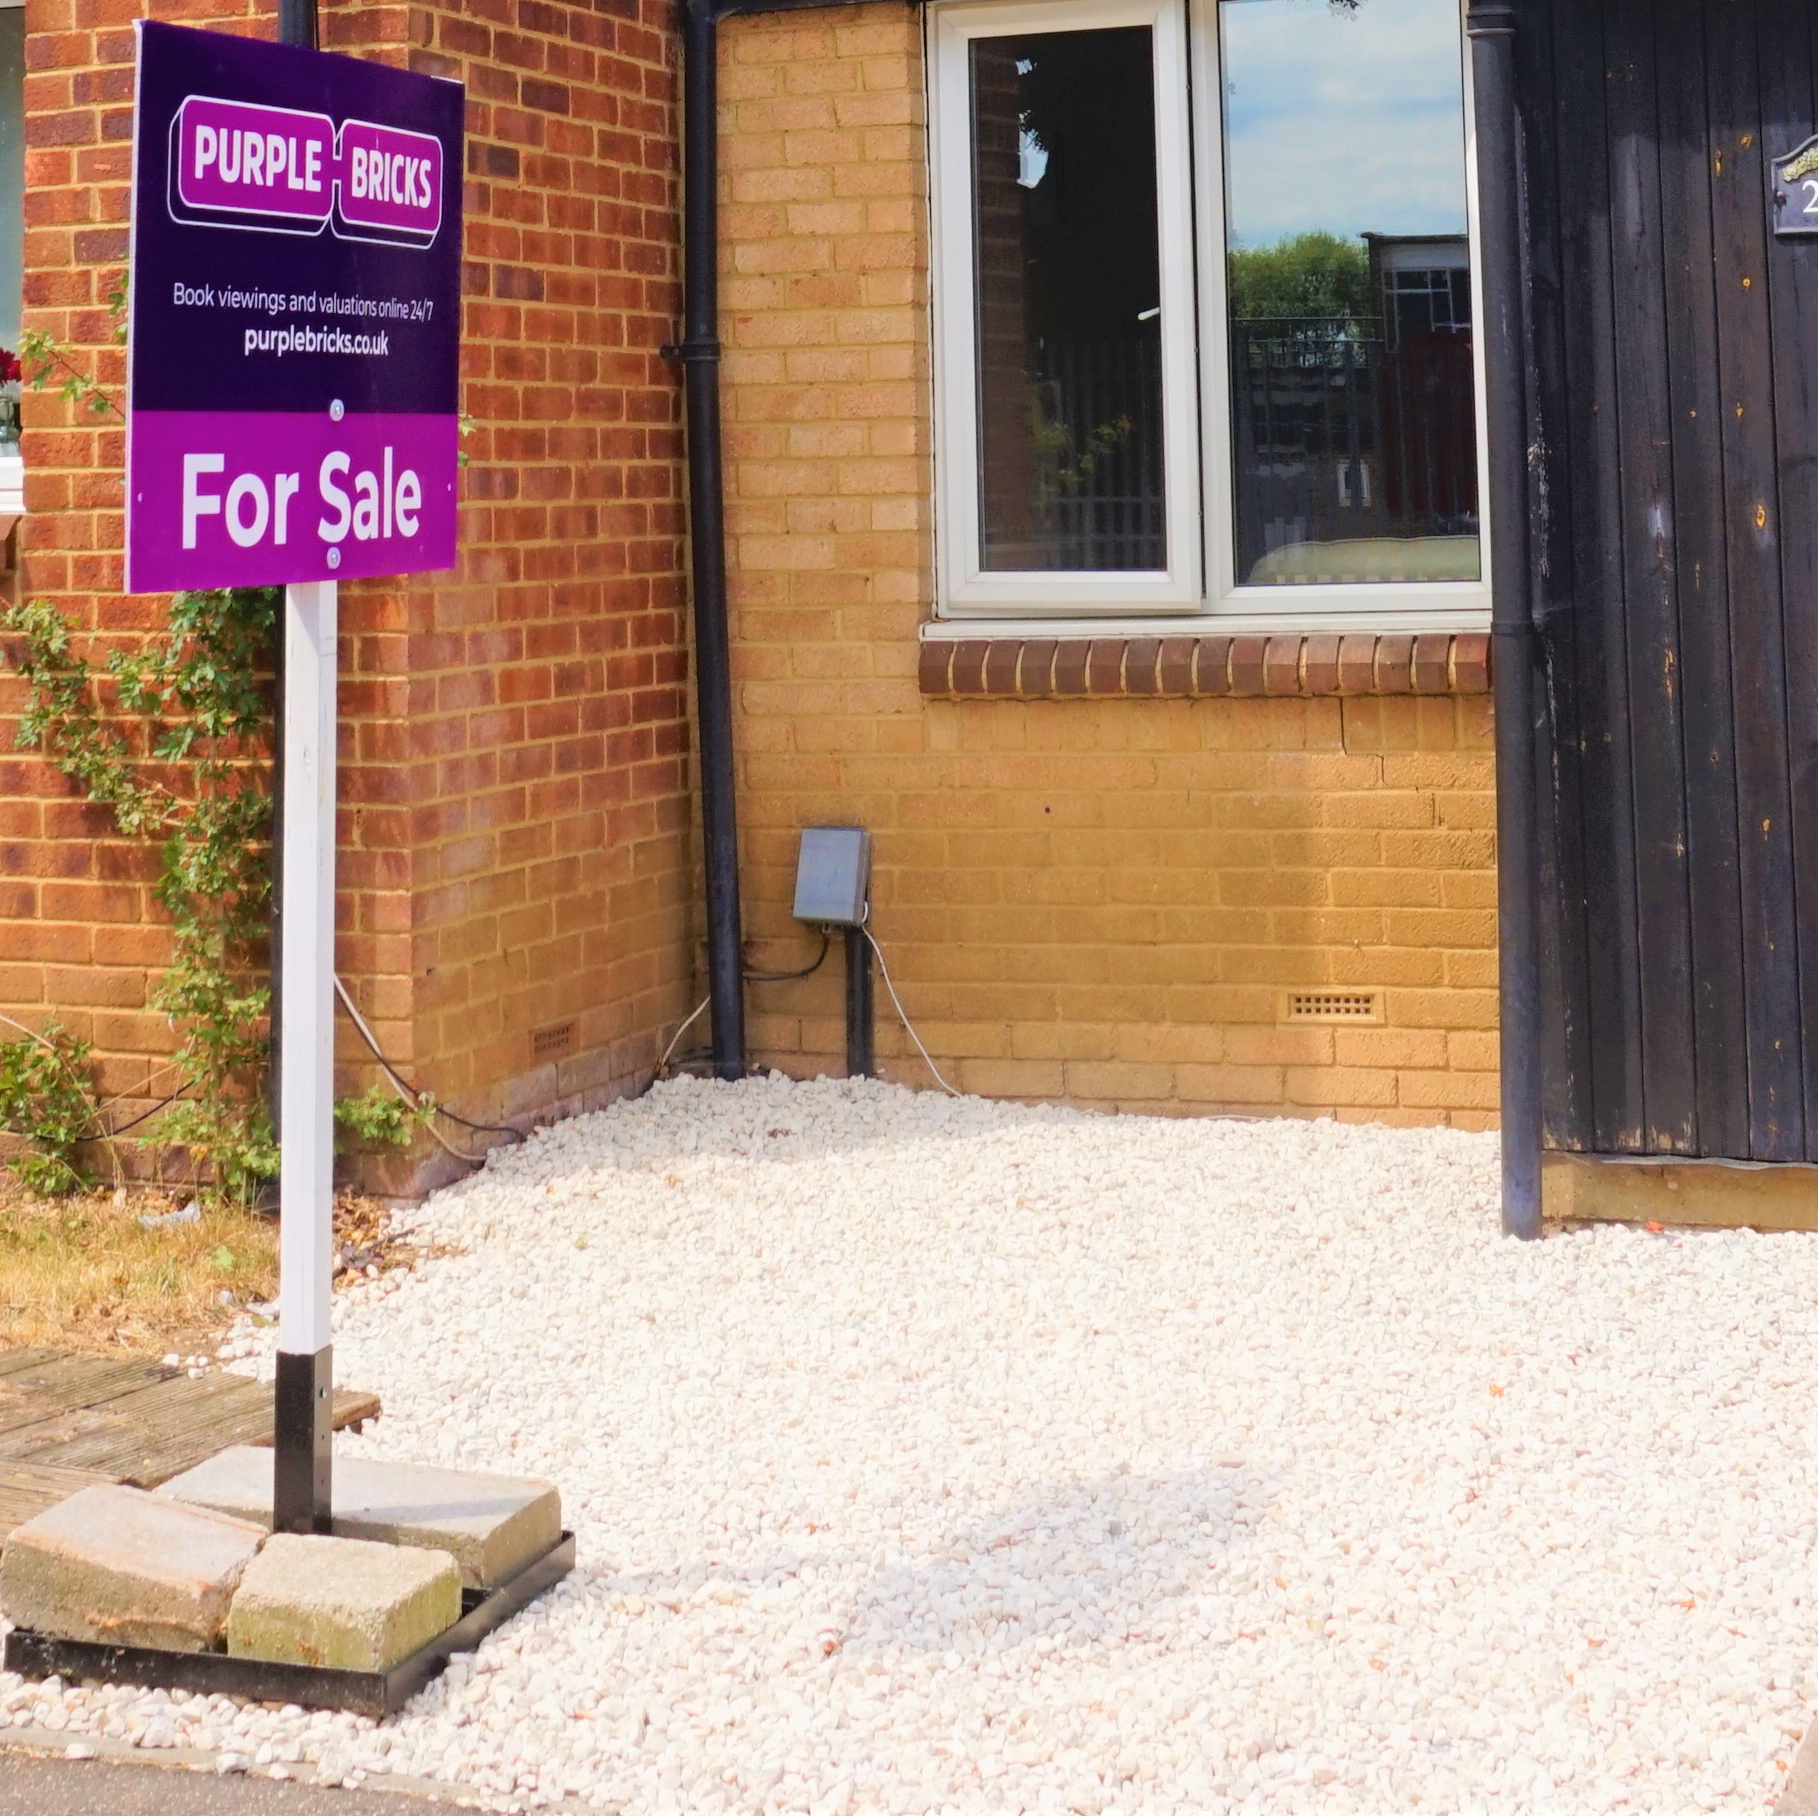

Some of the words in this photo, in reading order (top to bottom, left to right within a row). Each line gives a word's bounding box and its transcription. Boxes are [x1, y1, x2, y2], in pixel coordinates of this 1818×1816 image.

[194, 124, 323, 193] PURPLE
[351, 146, 432, 209] BRICKS
[173, 282, 215, 307] Book
[218, 284, 287, 316] viewings
[289, 290, 317, 313] and
[319, 291, 378, 317] valuations
[378, 297, 410, 320] online
[409, 297, 434, 322] 24/7
[244, 324, 389, 357] purplebricks.co.uk
[182, 452, 300, 550] For
[317, 445, 422, 543] Sale
